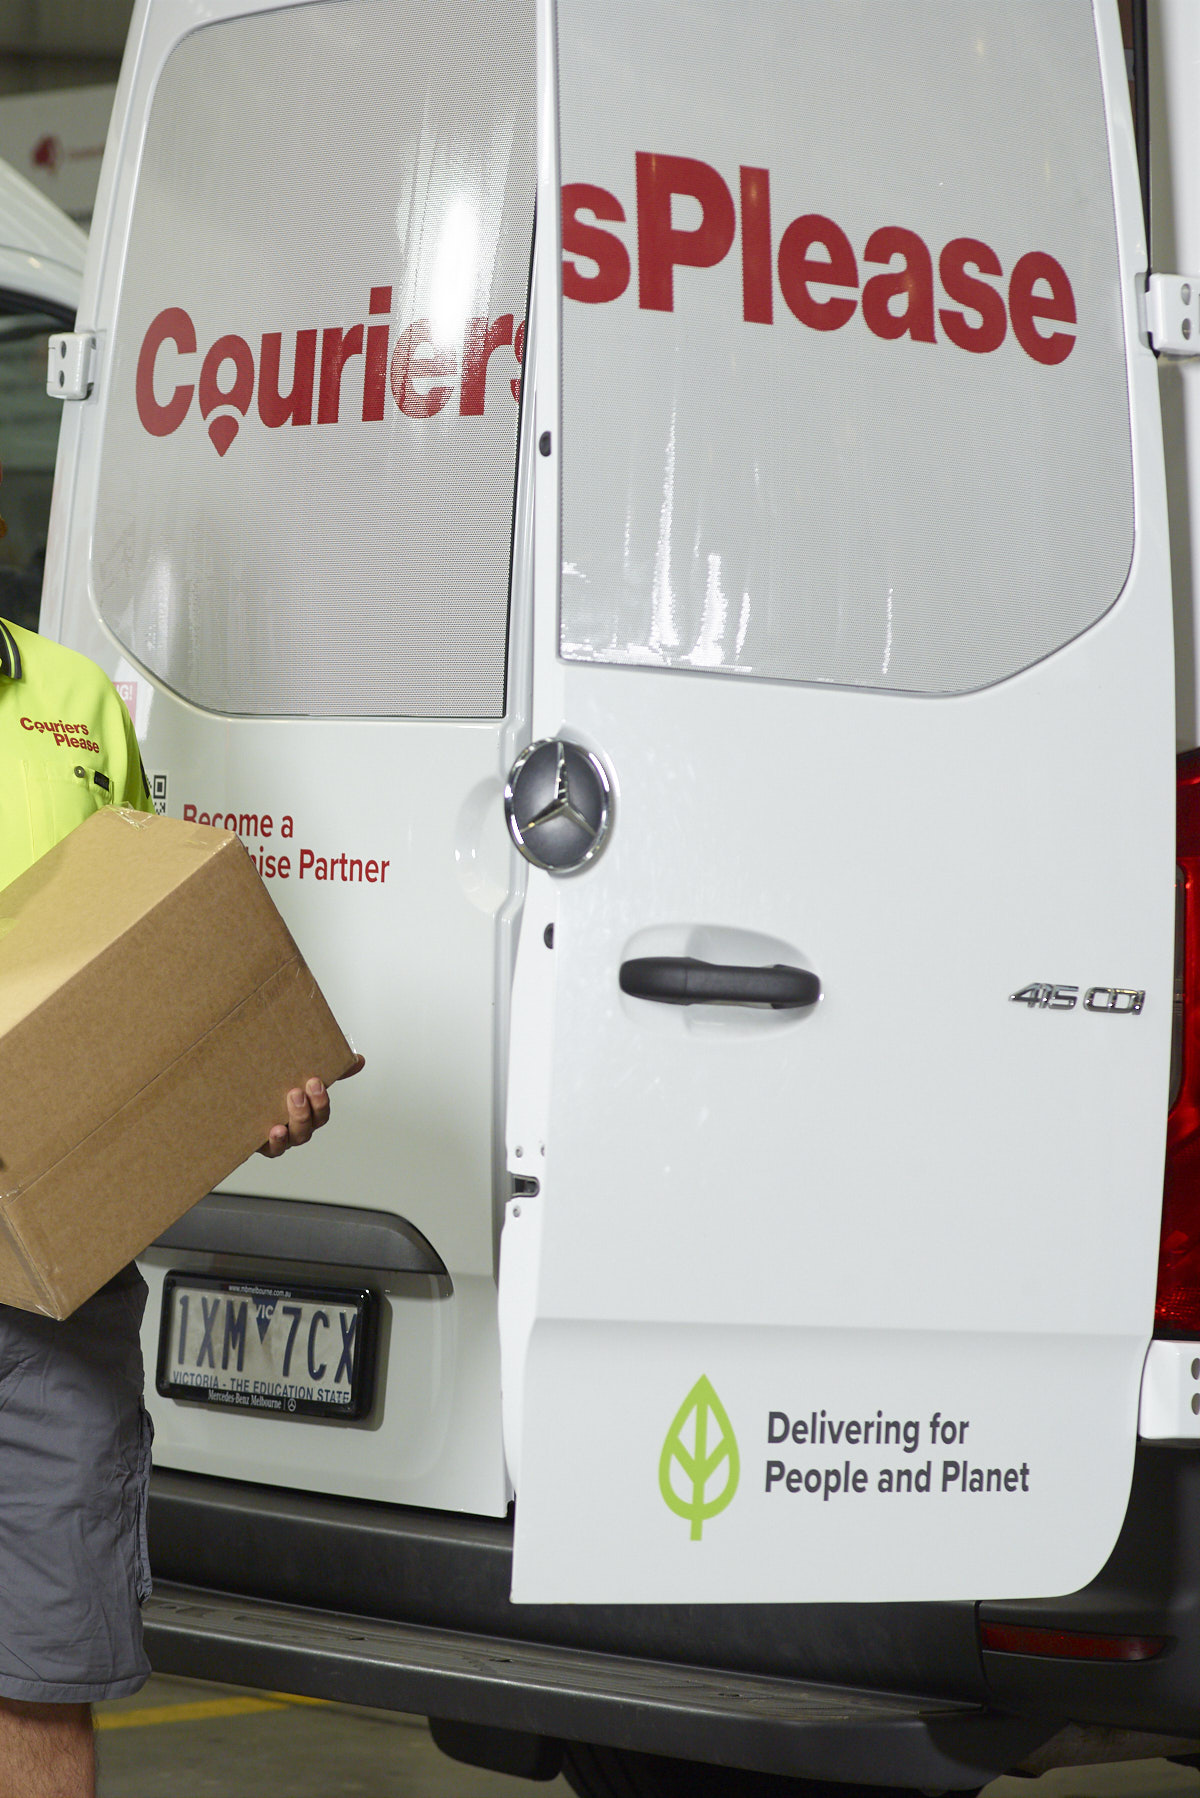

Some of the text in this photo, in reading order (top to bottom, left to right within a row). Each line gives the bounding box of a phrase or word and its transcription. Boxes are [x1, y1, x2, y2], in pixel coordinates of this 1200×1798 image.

[20, 717, 89, 735] Couriers
[53, 733, 100, 753] Please
[280, 815, 294, 838] a
[299, 848, 390, 883] Partner
[1008, 982, 1146, 1015] 415 CDI
[255, 1303, 274, 1319] VIC
[178, 1294, 357, 1385] 1XM 7CX
[173, 1370, 219, 1388] VICTORIA
[230, 1378, 250, 1393] THE
[253, 1380, 313, 1400] EDUCATION
[317, 1389, 350, 1404] STATE
[208, 1388, 282, 1409] Mercedes-Benz Melbourne
[767, 1409, 970, 1453] Delivering for
[764, 1460, 1030, 1501] People and Planet
